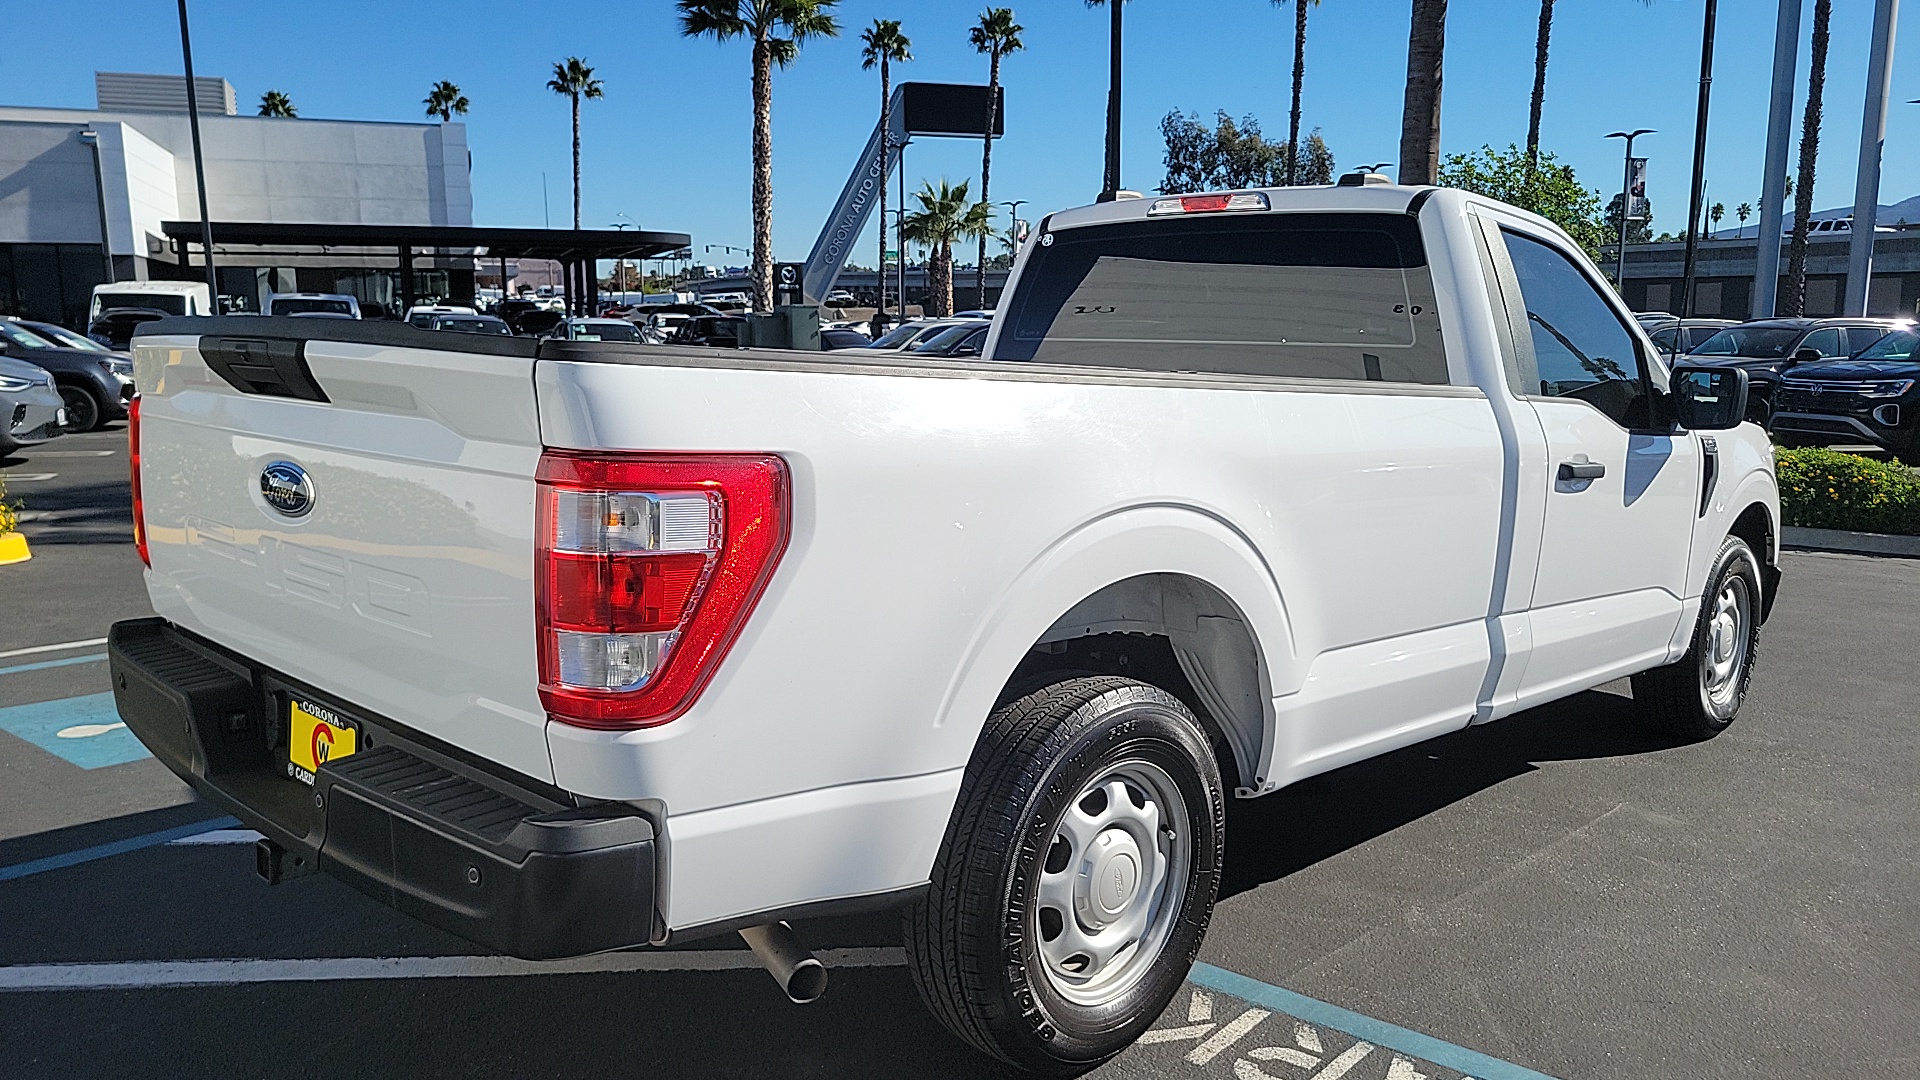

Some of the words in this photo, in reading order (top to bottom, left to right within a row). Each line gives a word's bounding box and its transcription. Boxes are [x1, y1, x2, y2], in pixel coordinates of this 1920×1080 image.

[824, 213, 857, 265] CORONA
[850, 177, 874, 214] AUTO
[868, 131, 899, 178] CEER
[302, 701, 340, 727] CORONA
